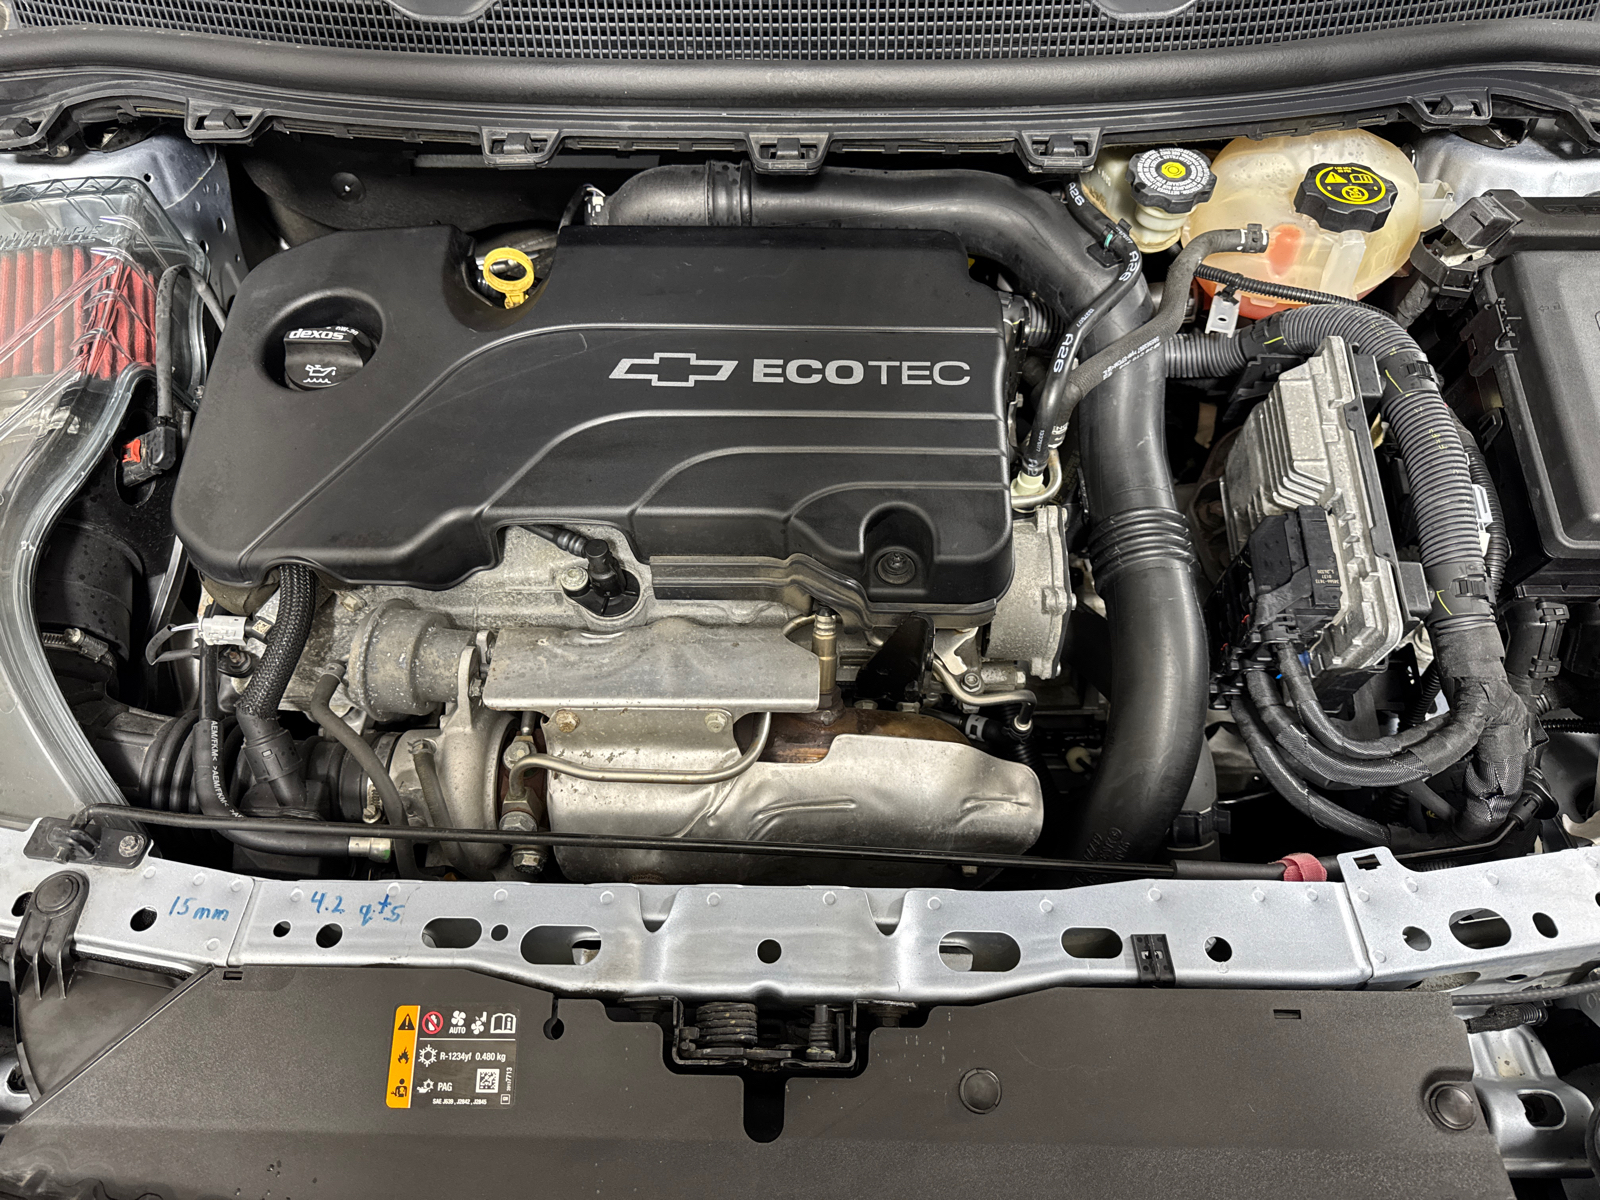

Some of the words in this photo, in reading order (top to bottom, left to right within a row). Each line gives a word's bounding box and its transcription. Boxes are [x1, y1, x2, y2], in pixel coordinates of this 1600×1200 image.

[1068, 182, 1085, 206] A26
[1119, 251, 1139, 282] A26
[289, 328, 345, 340] dexos
[1053, 333, 1074, 373] A26
[752, 359, 971, 386] ECOTEC
[310, 891, 346, 915] 4.2
[449, 1026, 466, 1034] AUTO
[440, 1051, 472, 1062] R-1234yf
[475, 1052, 496, 1061] 0.480
[496, 1052, 506, 1063] kg
[437, 1082, 453, 1092] PAG
